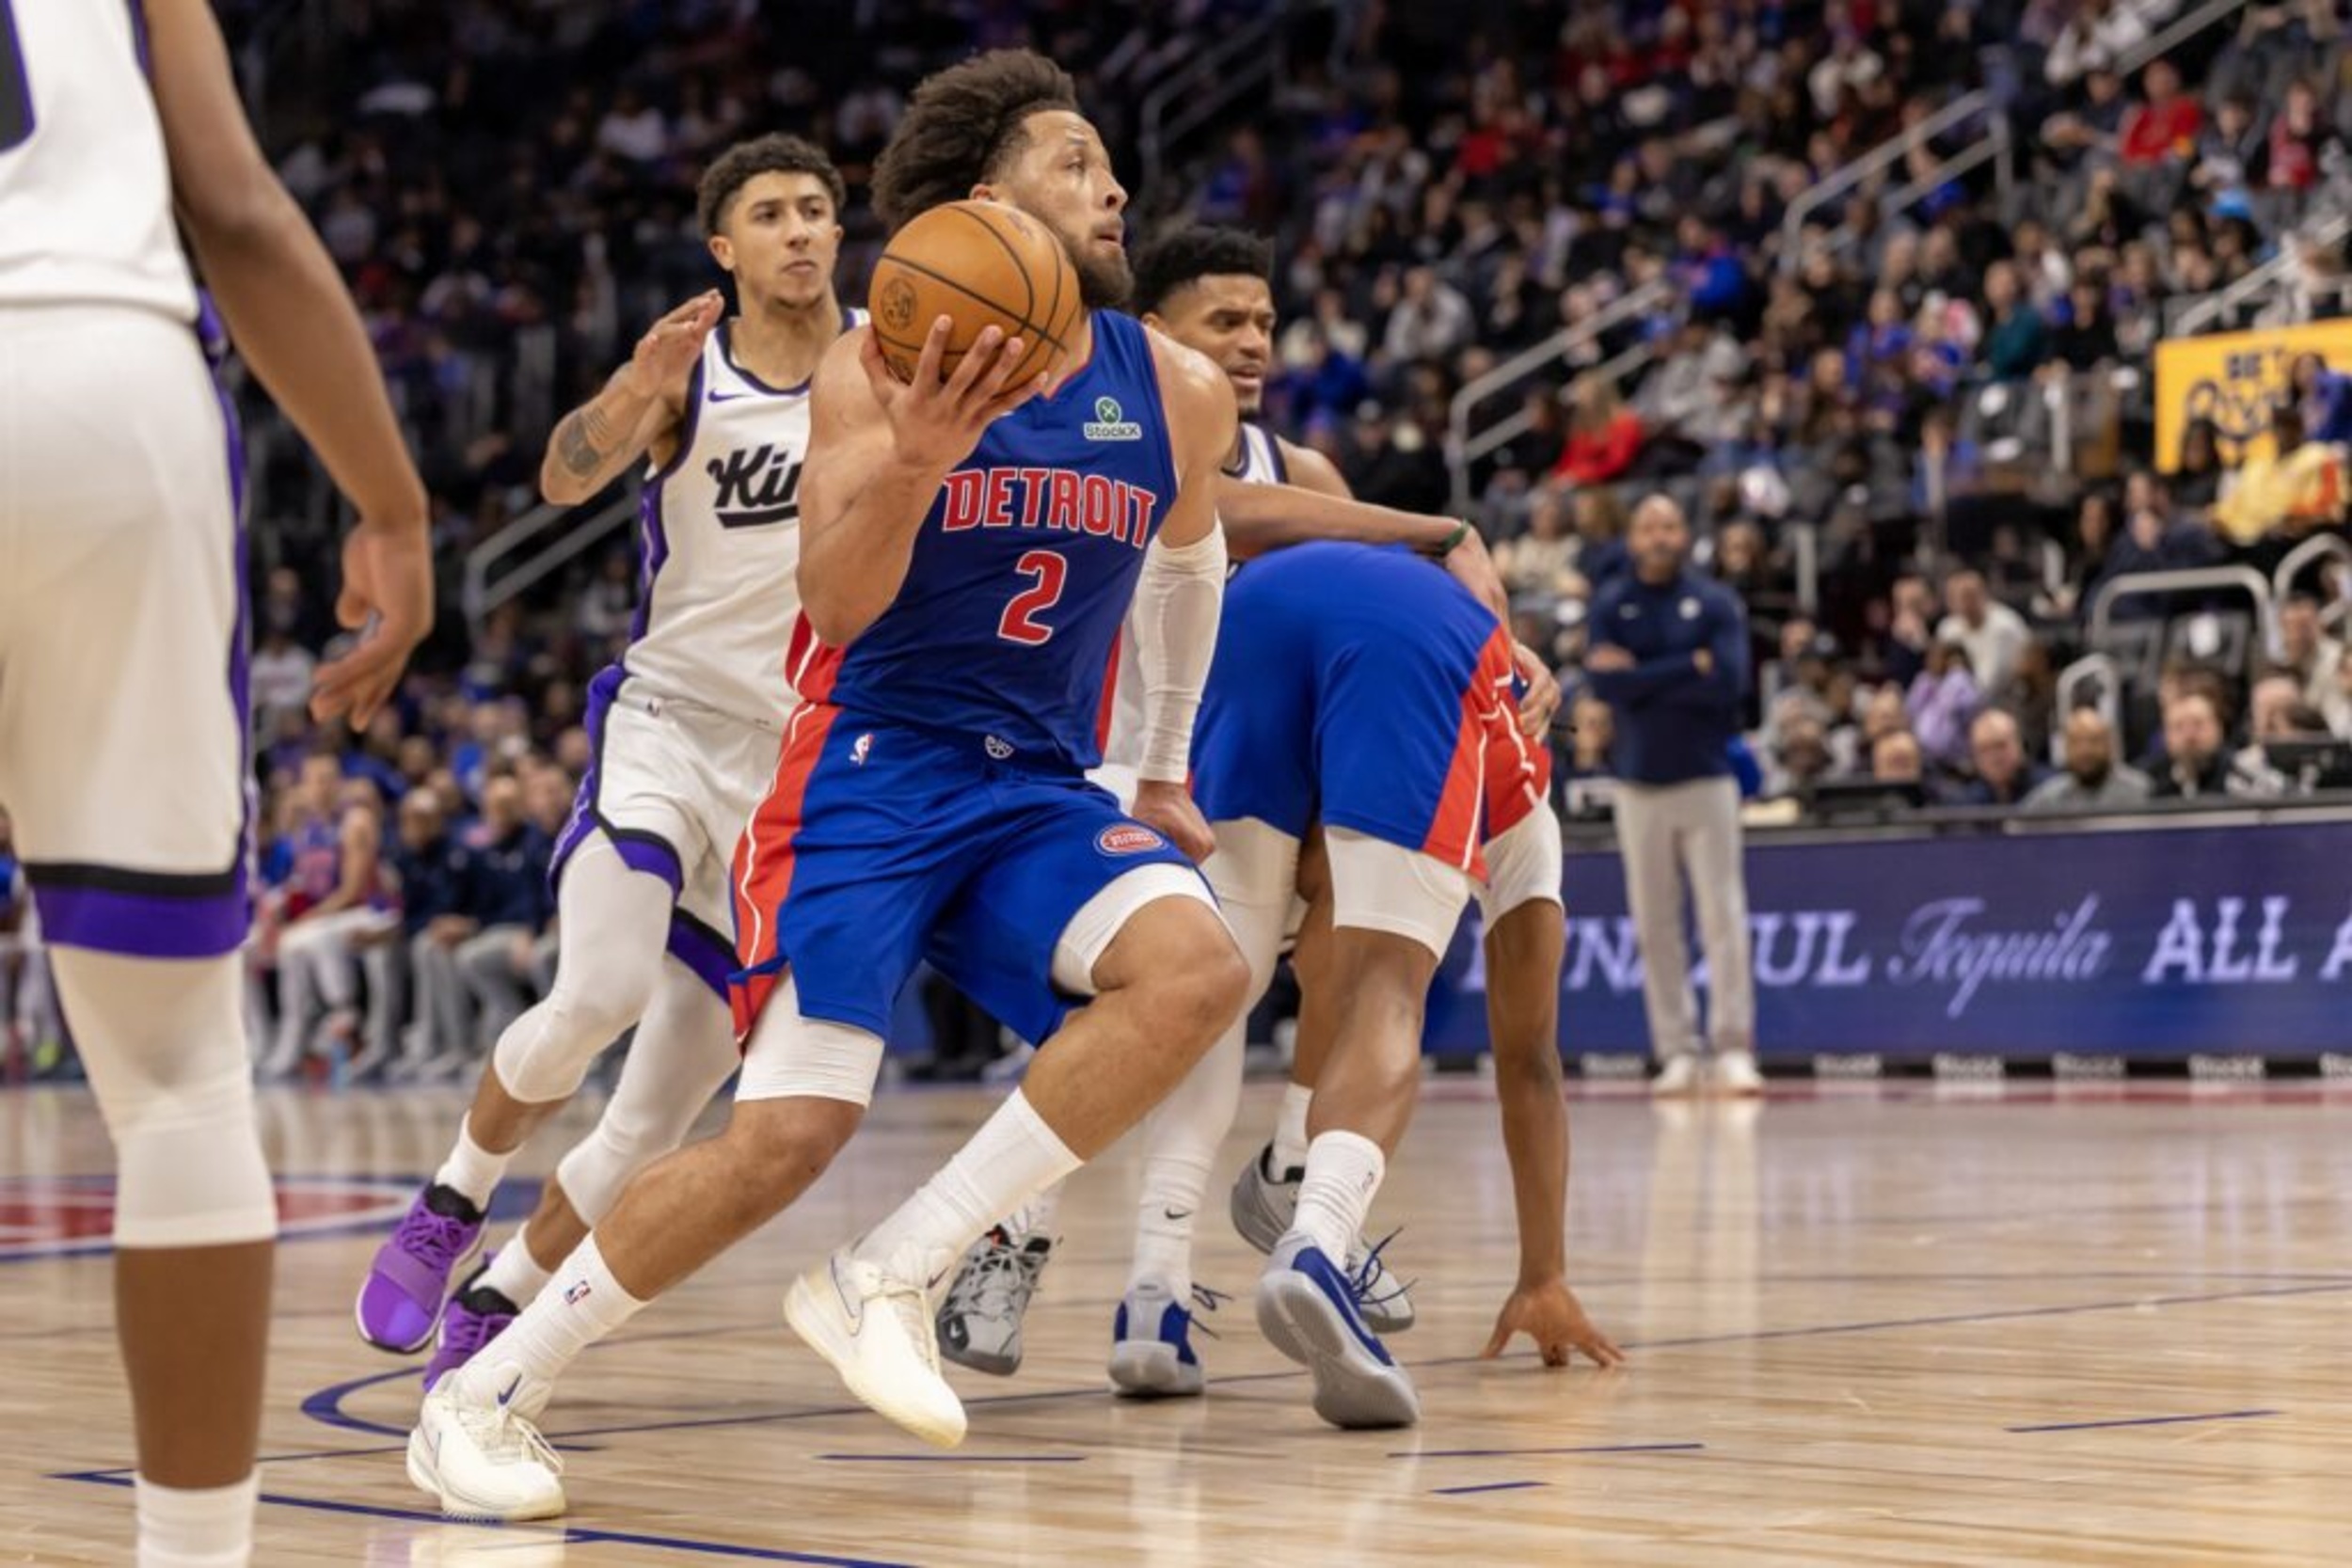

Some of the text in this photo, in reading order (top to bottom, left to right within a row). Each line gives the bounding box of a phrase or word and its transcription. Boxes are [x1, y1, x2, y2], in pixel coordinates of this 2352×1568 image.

[943, 468, 1156, 548] DETROIT
[997, 549, 1067, 646] 2
[1886, 891, 2110, 1019] Tequila
[2142, 895, 2298, 983] ALL
